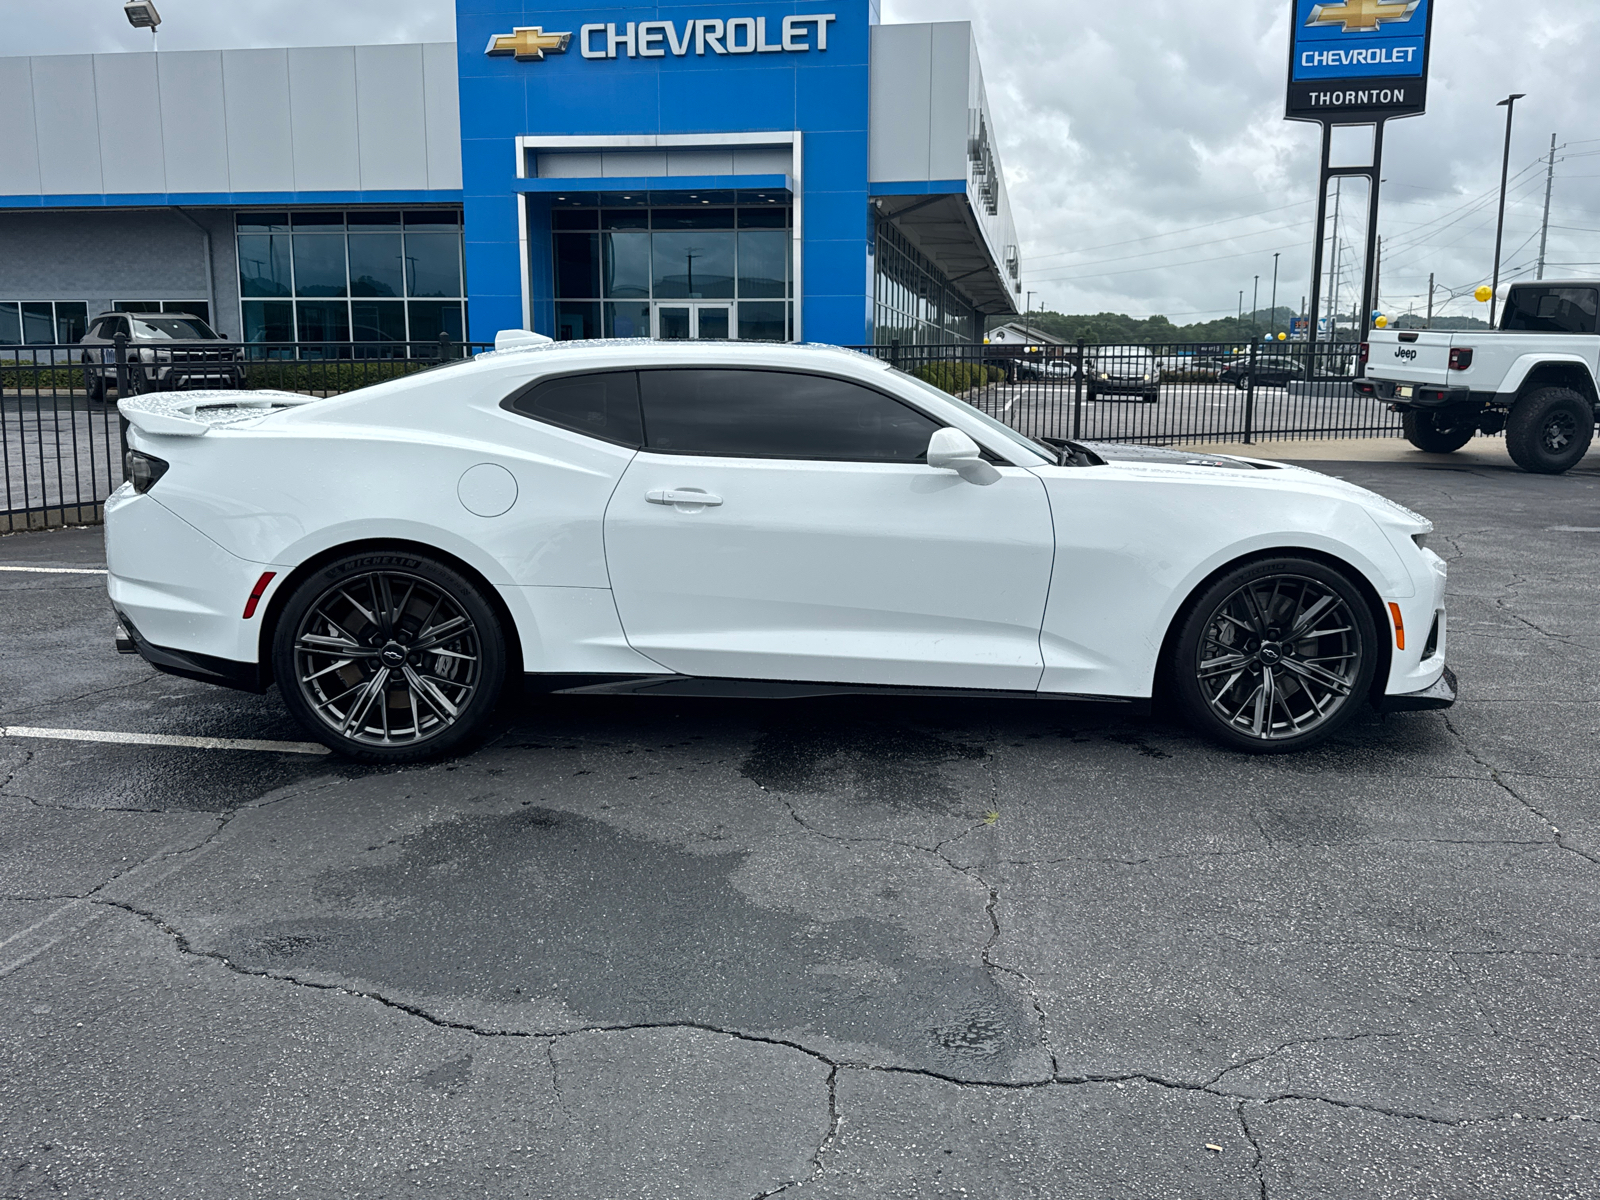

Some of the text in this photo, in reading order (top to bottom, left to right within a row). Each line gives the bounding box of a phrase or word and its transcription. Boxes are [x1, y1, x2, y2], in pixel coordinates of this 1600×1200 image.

[580, 14, 836, 59] CHEVROLET
[1302, 47, 1416, 66] CHEVROLET
[1309, 89, 1404, 105] THORNTON
[1394, 346, 1417, 361] Jeep
[345, 556, 417, 571] MICHELIN
